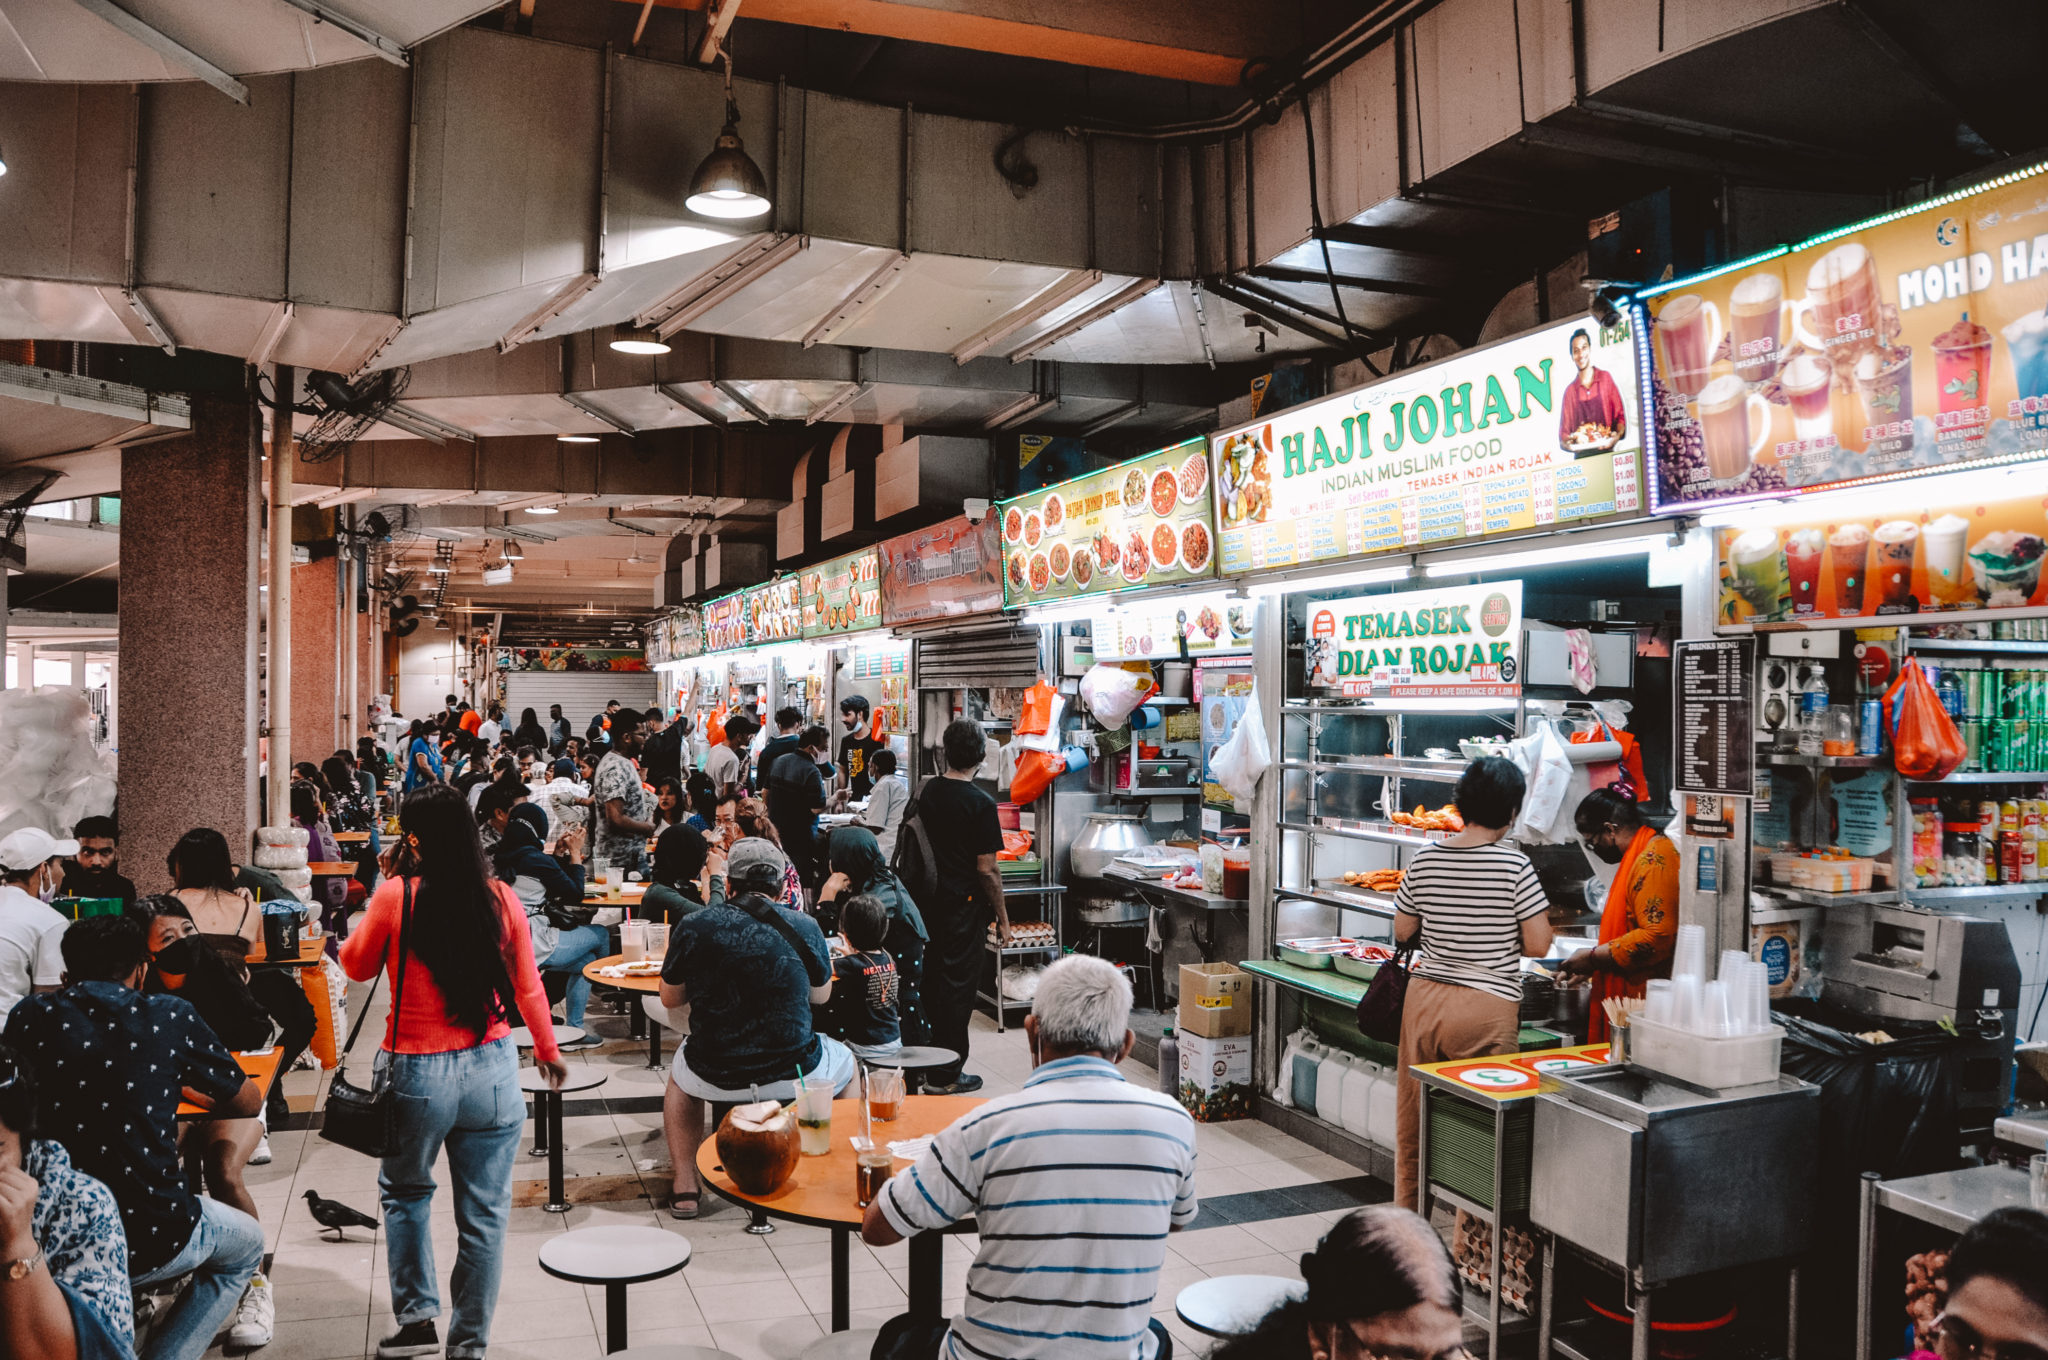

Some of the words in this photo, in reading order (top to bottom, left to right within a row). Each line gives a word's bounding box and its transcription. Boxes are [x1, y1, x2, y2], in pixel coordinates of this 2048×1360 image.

[1898, 251, 1994, 311] MOHD
[1281, 412, 1373, 478] HAJI
[1384, 358, 1553, 452] JOHAN
[1665, 419, 1692, 430] COFFEE
[2009, 416, 2036, 429] BLUE
[1938, 425, 1985, 441] BANDUNG
[1937, 438, 1987, 454] DINASOUR
[1321, 468, 1374, 494] INDIAN
[1378, 451, 1444, 481] MUSLIM
[1450, 438, 1503, 465] FOOD
[1407, 472, 1459, 491] TEMASEK
[1463, 463, 1504, 480] INDIAN
[1509, 452, 1553, 470] ROJAK
[1556, 465, 1582, 477] HOTDOG
[1615, 454, 1634, 466] $0.80
[1556, 478, 1587, 491] COCONUT
[1615, 469, 1635, 480] $1.00
[1558, 494, 1579, 505] SAYUR
[1616, 486, 1636, 495] $1.00
[1559, 505, 1585, 518] FLOWER
[1617, 499, 1637, 510] $1.00
[1343, 604, 1472, 641] TEMASEK
[1688, 642, 1716, 651] DRINKS
[1716, 641, 1739, 650] MENU
[1409, 641, 1511, 675] ROJAK
[1395, 686, 1417, 696] PLEASE
[1418, 686, 1433, 696] KEEP
[1433, 686, 1440, 696] A
[1439, 686, 1456, 696] SAFE
[1456, 685, 1487, 696] DISTANCE
[1487, 685, 1497, 695] OF
[1223, 1043, 1236, 1051] EVA
